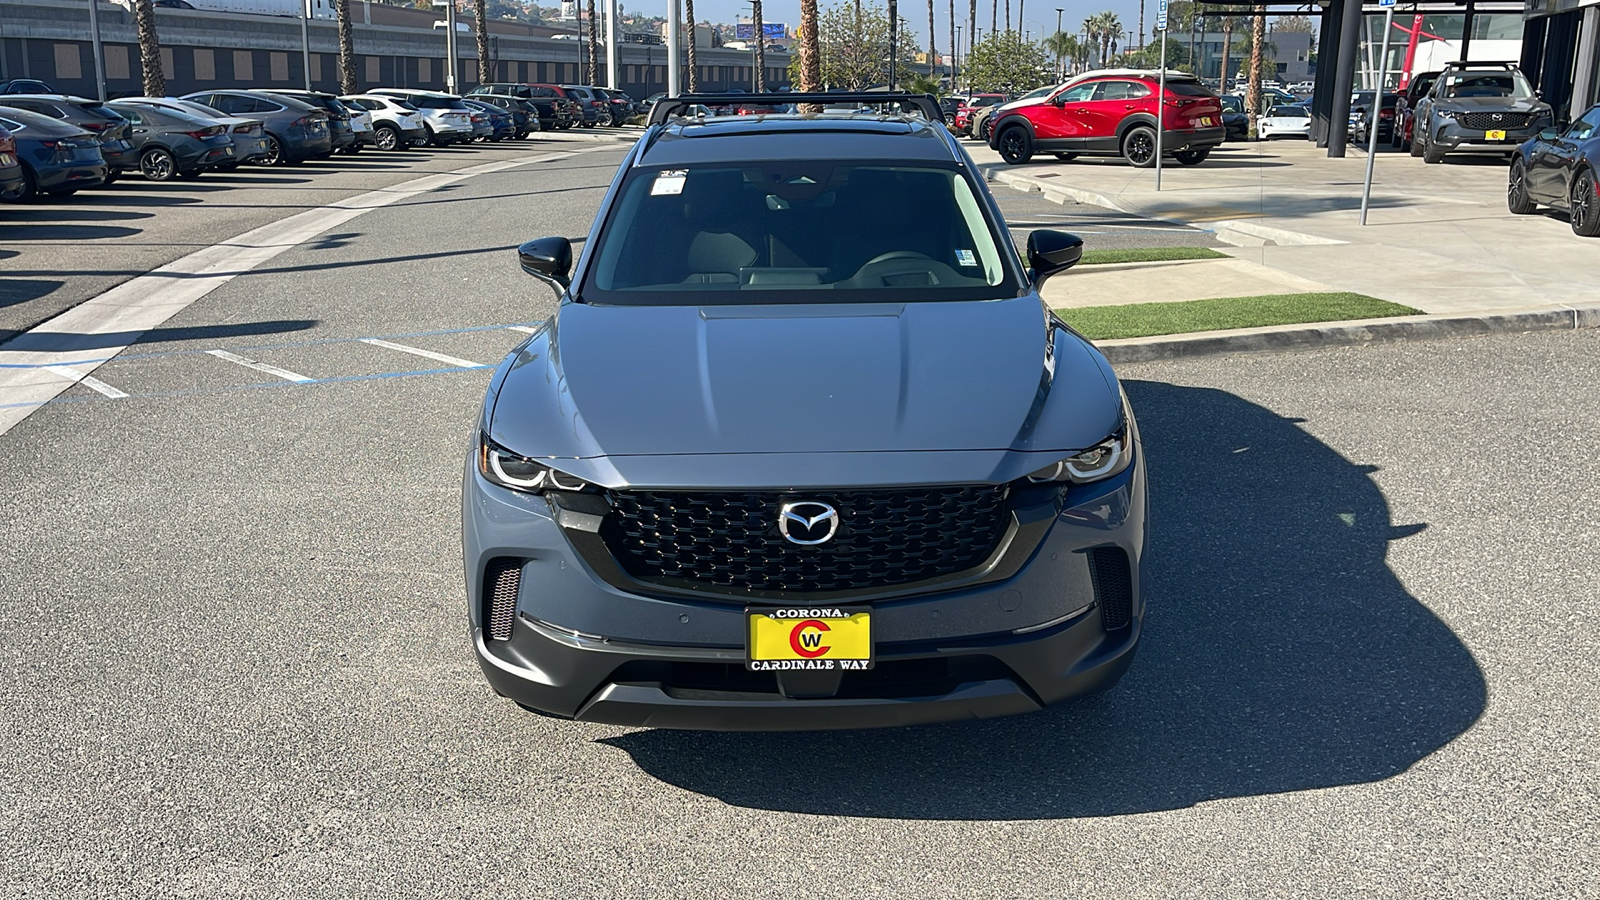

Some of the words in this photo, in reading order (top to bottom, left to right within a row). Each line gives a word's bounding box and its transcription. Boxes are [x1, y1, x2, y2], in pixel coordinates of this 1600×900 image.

[776, 608, 842, 618] CORONA
[789, 619, 832, 659] C
[801, 633, 823, 648] W
[751, 660, 835, 671] CARDINALE
[839, 660, 870, 670] WAY
